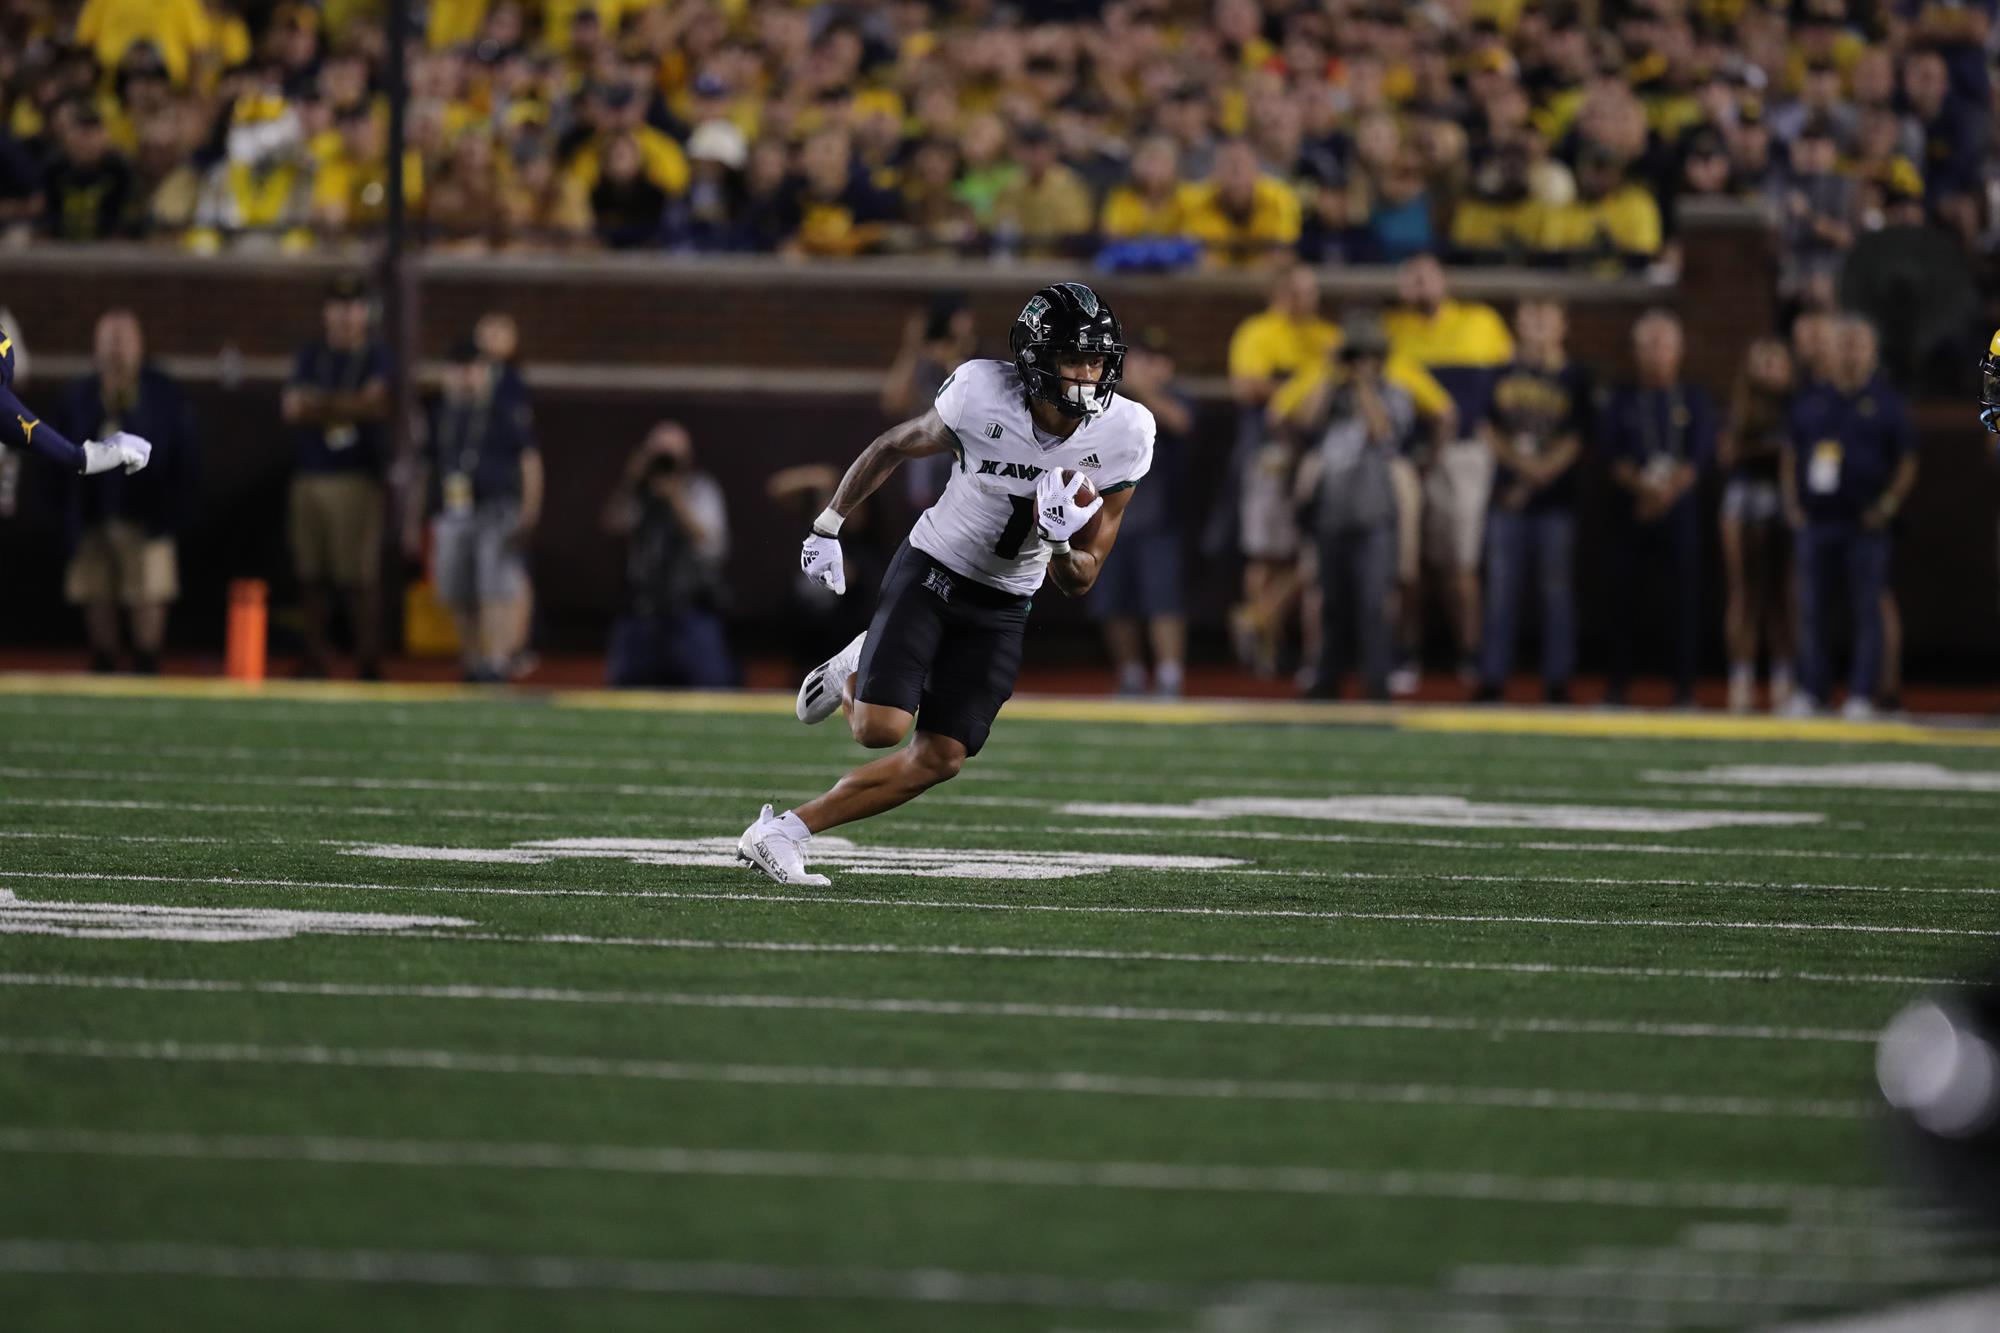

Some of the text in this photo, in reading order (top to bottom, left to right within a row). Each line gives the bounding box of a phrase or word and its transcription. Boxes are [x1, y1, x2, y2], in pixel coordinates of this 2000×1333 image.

[976, 459, 1047, 481] HAW
[1078, 459, 1101, 469] adidas
[995, 493, 1034, 560] 1
[1043, 510, 1066, 526] adidas
